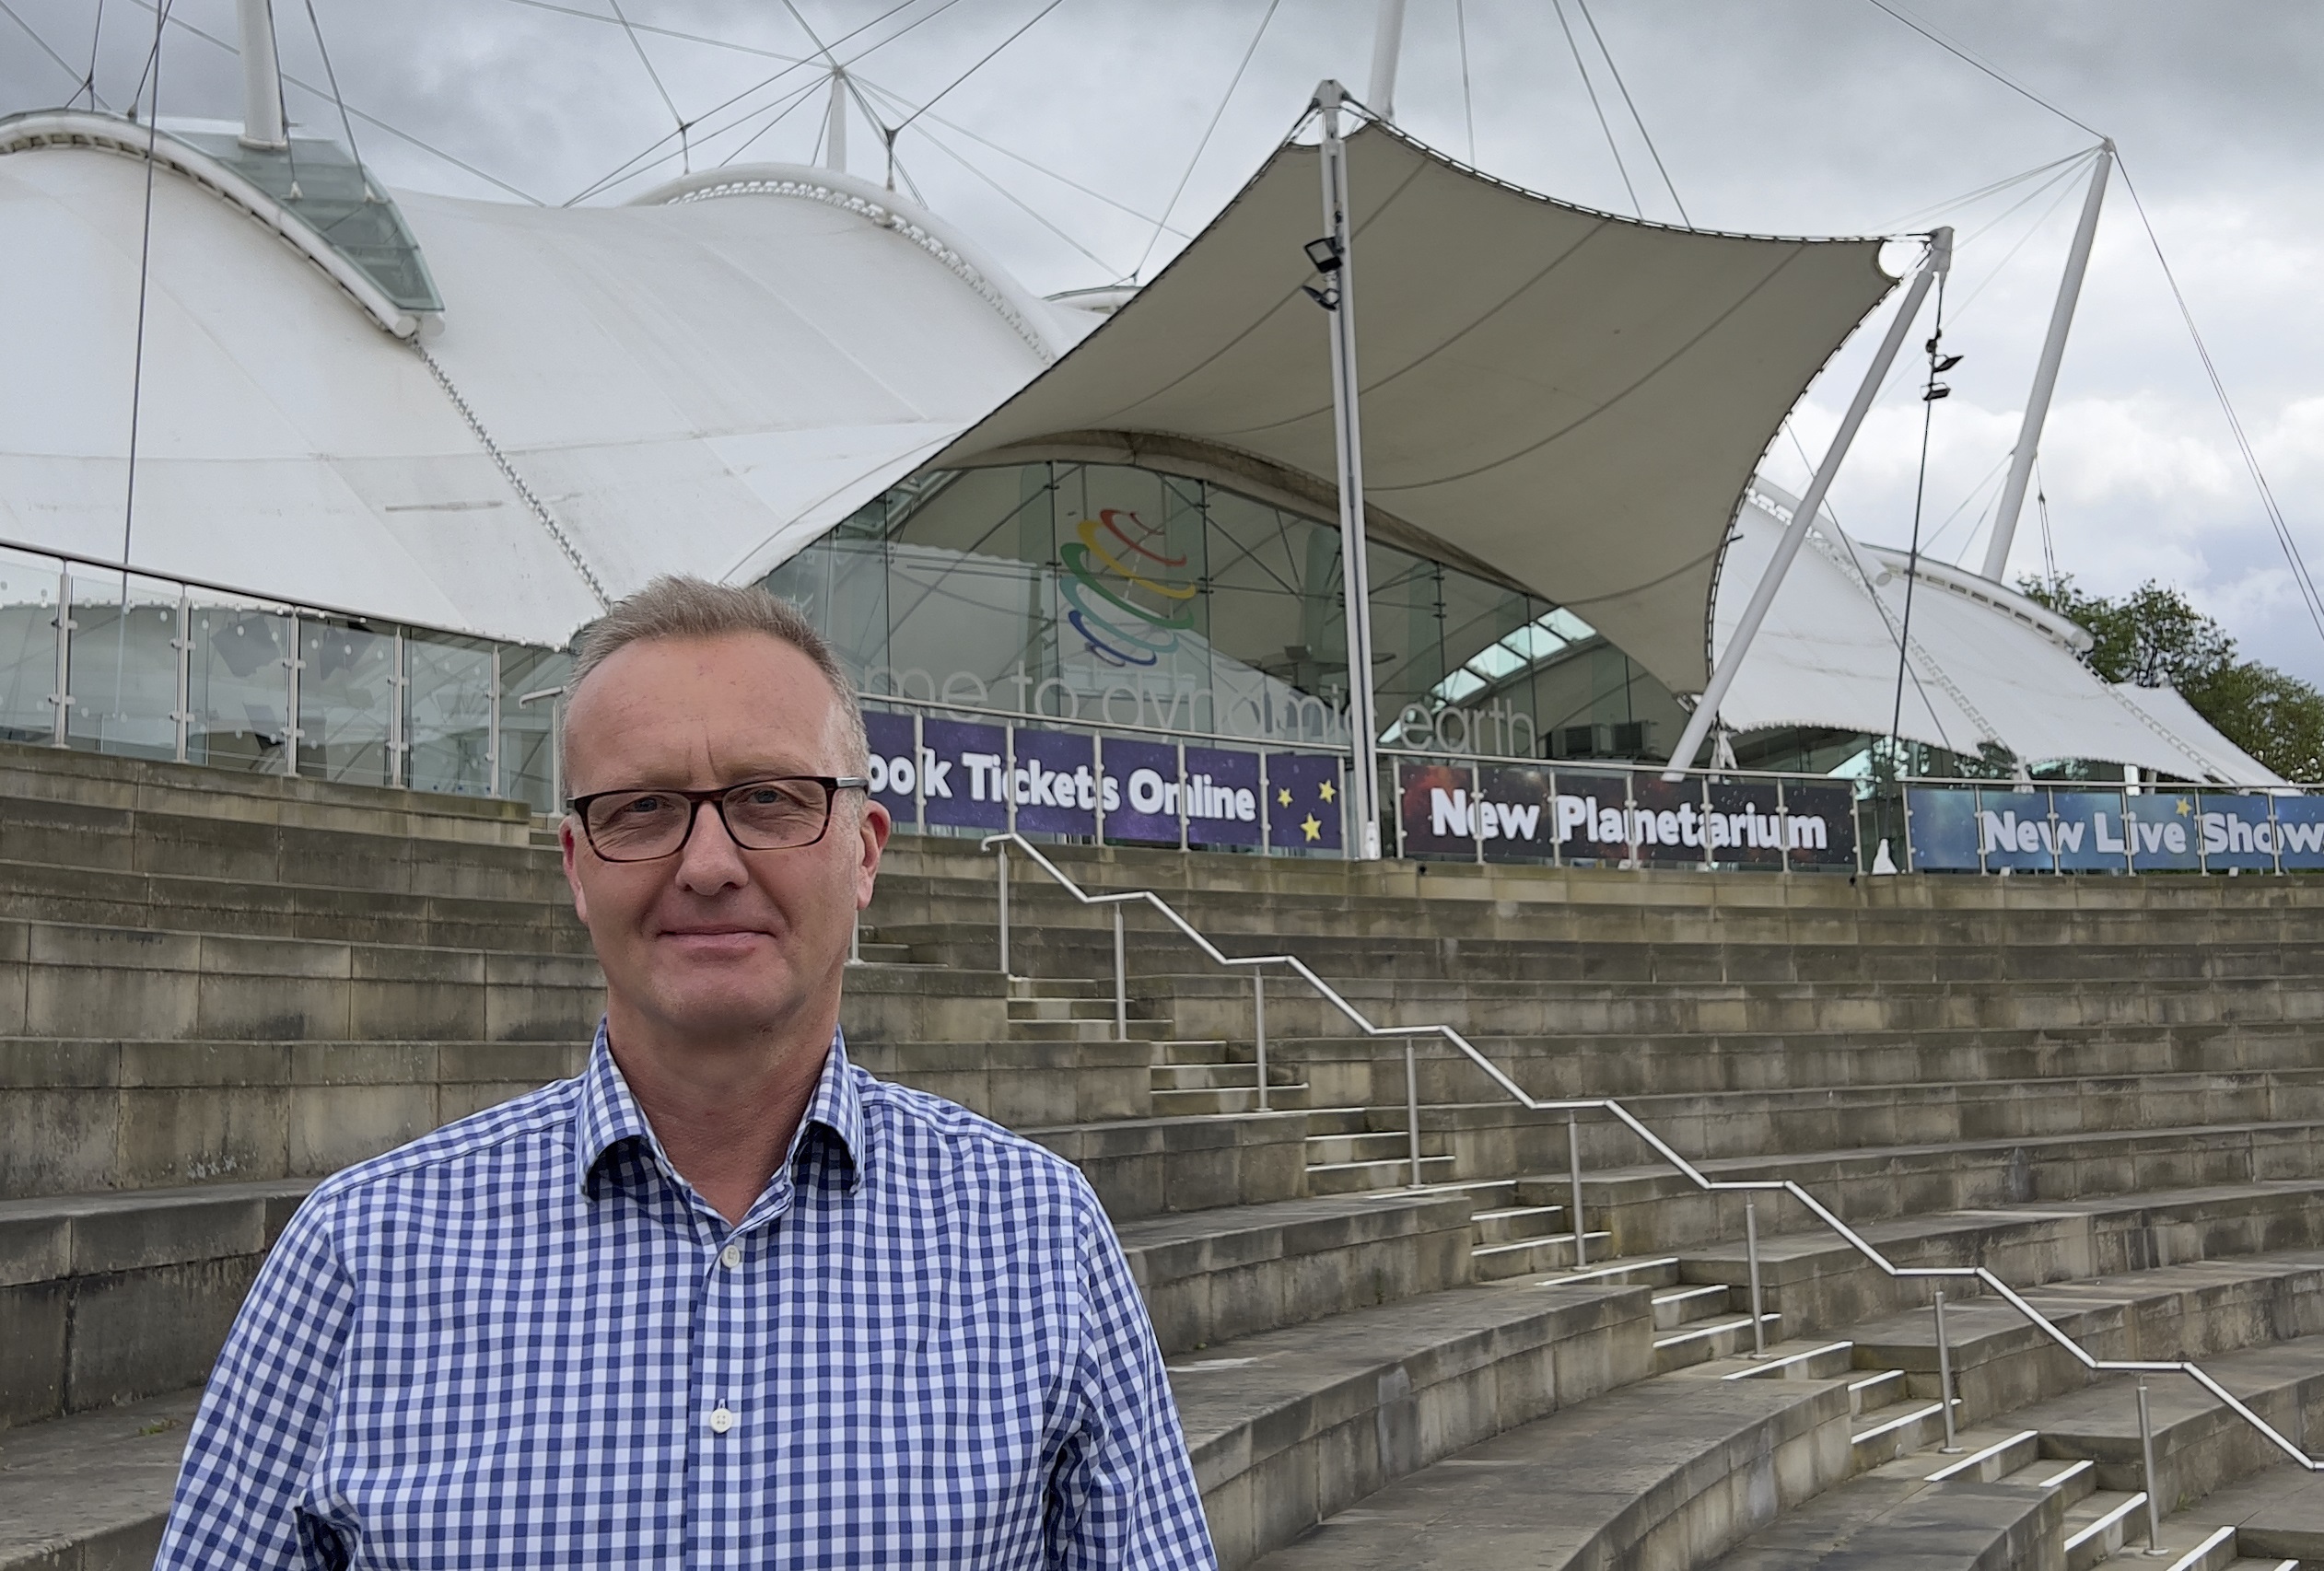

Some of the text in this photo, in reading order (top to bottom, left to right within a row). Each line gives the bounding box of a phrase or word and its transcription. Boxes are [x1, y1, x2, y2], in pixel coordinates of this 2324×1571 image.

[1010, 660, 1080, 731] to
[1102, 668, 1378, 744] dynami
[1398, 696, 1537, 758] earth
[869, 748, 1257, 822] ook Tickets Online
[1430, 787, 1828, 851] New Planetarium
[1980, 809, 2324, 855] New Live Show
